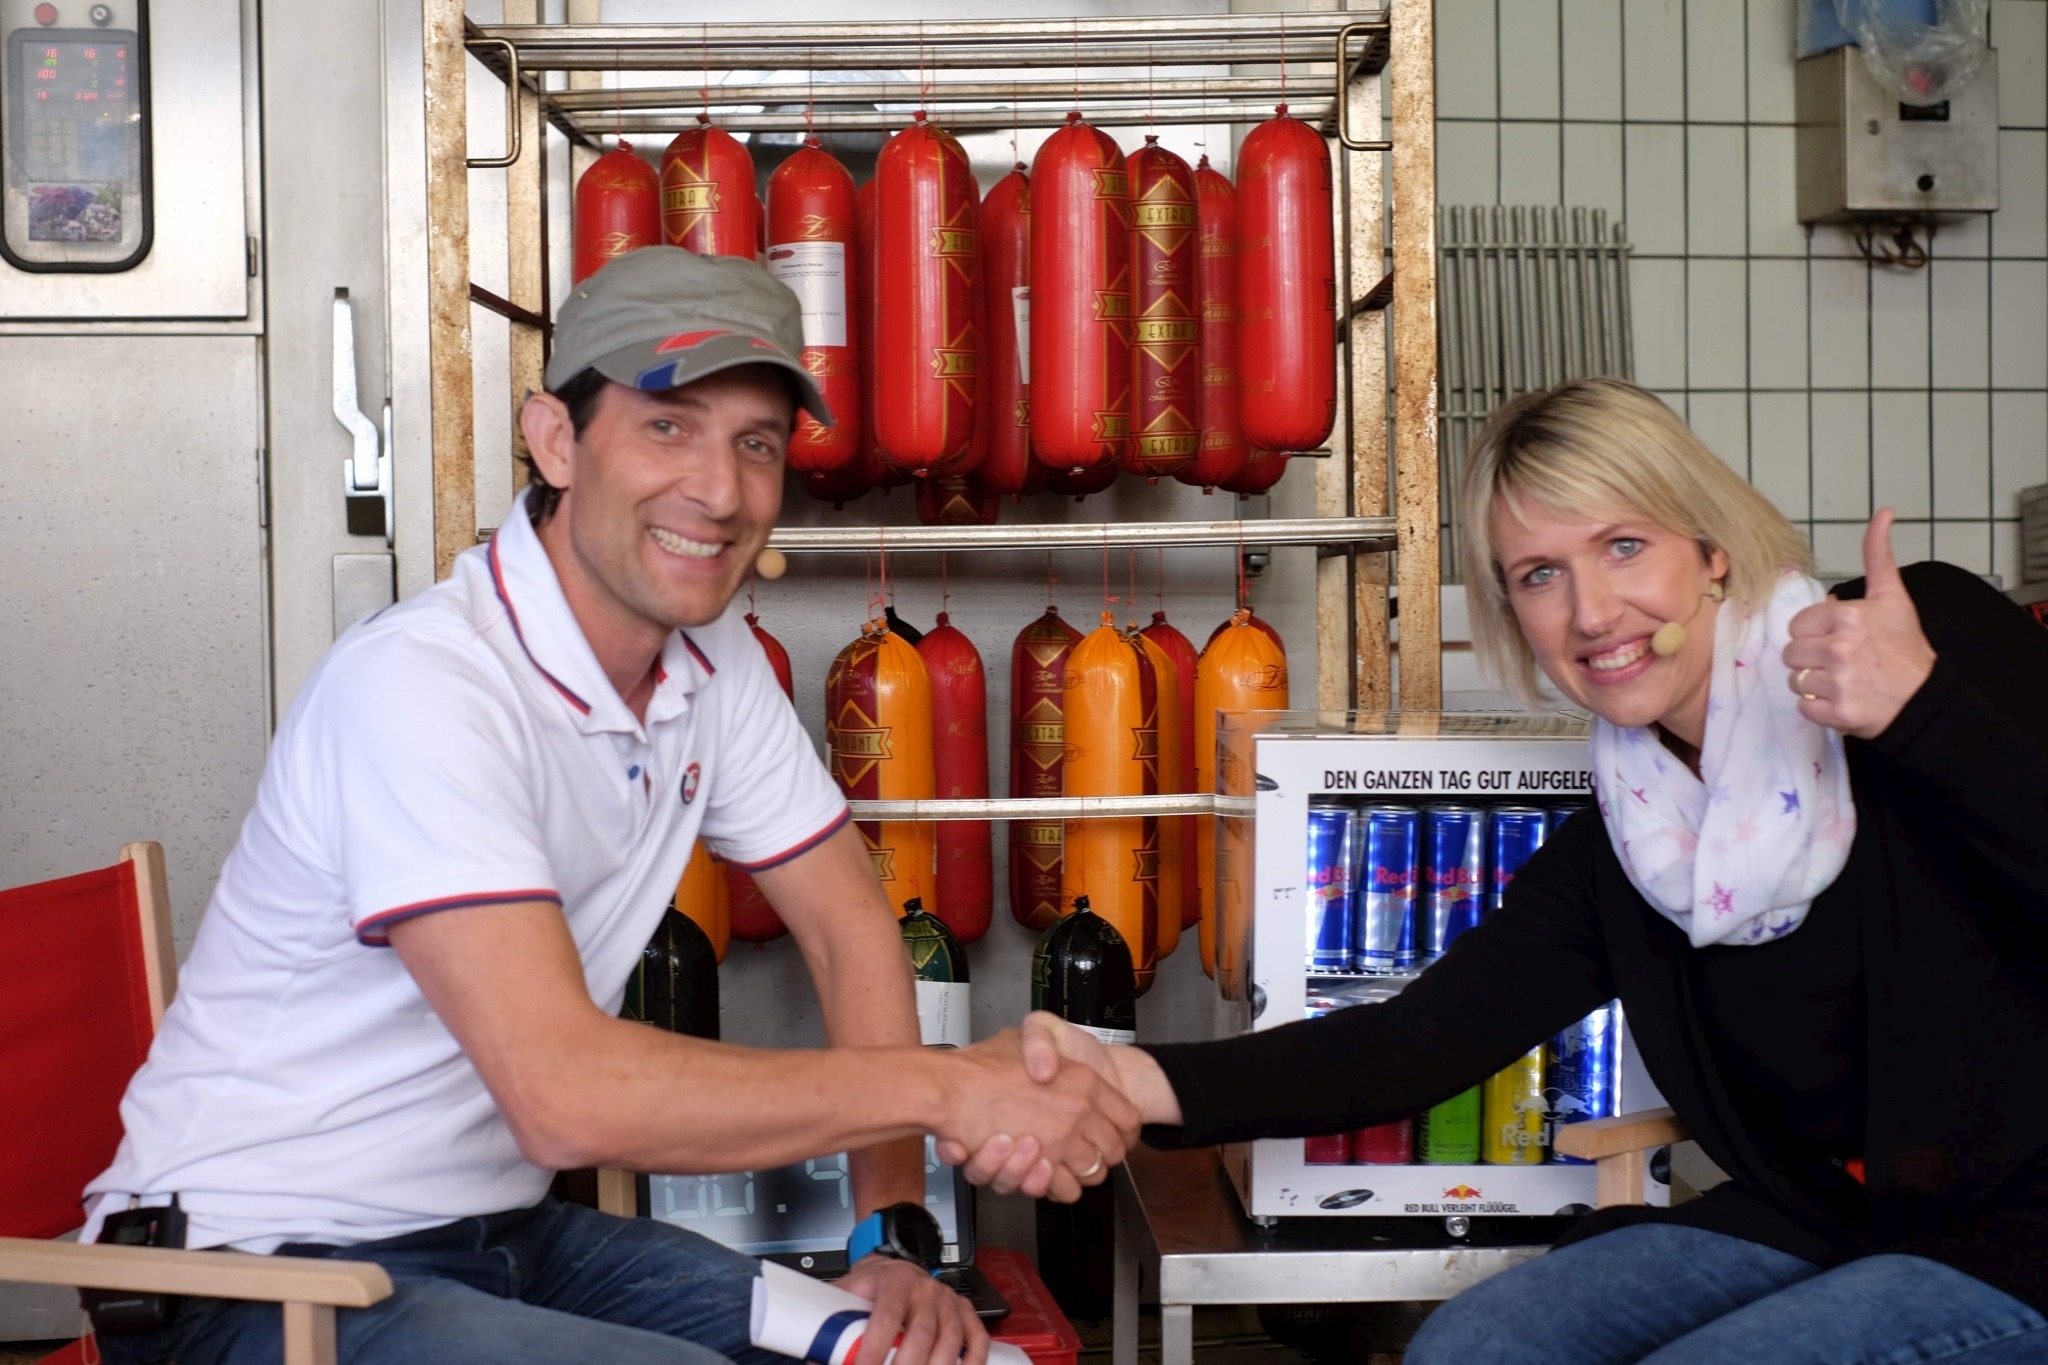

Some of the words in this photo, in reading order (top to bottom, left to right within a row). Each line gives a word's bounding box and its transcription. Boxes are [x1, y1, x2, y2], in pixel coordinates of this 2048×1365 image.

[46, 48, 58, 58] 16
[84, 48, 96, 59] 16
[1147, 207, 1187, 222] EXTRA
[1148, 323, 1187, 339] EXTRA
[1150, 439, 1190, 454] EXTRA
[1324, 770, 1356, 789] DEN
[1363, 770, 1433, 789] GANZEN
[1439, 770, 1471, 789] TAG
[1477, 770, 1512, 789] GUT
[1502, 1123, 1549, 1147] Red
[1404, 1203, 1419, 1213] RED
[1422, 1203, 1439, 1213] BULL
[1441, 1203, 1476, 1213] VERLEIHT
